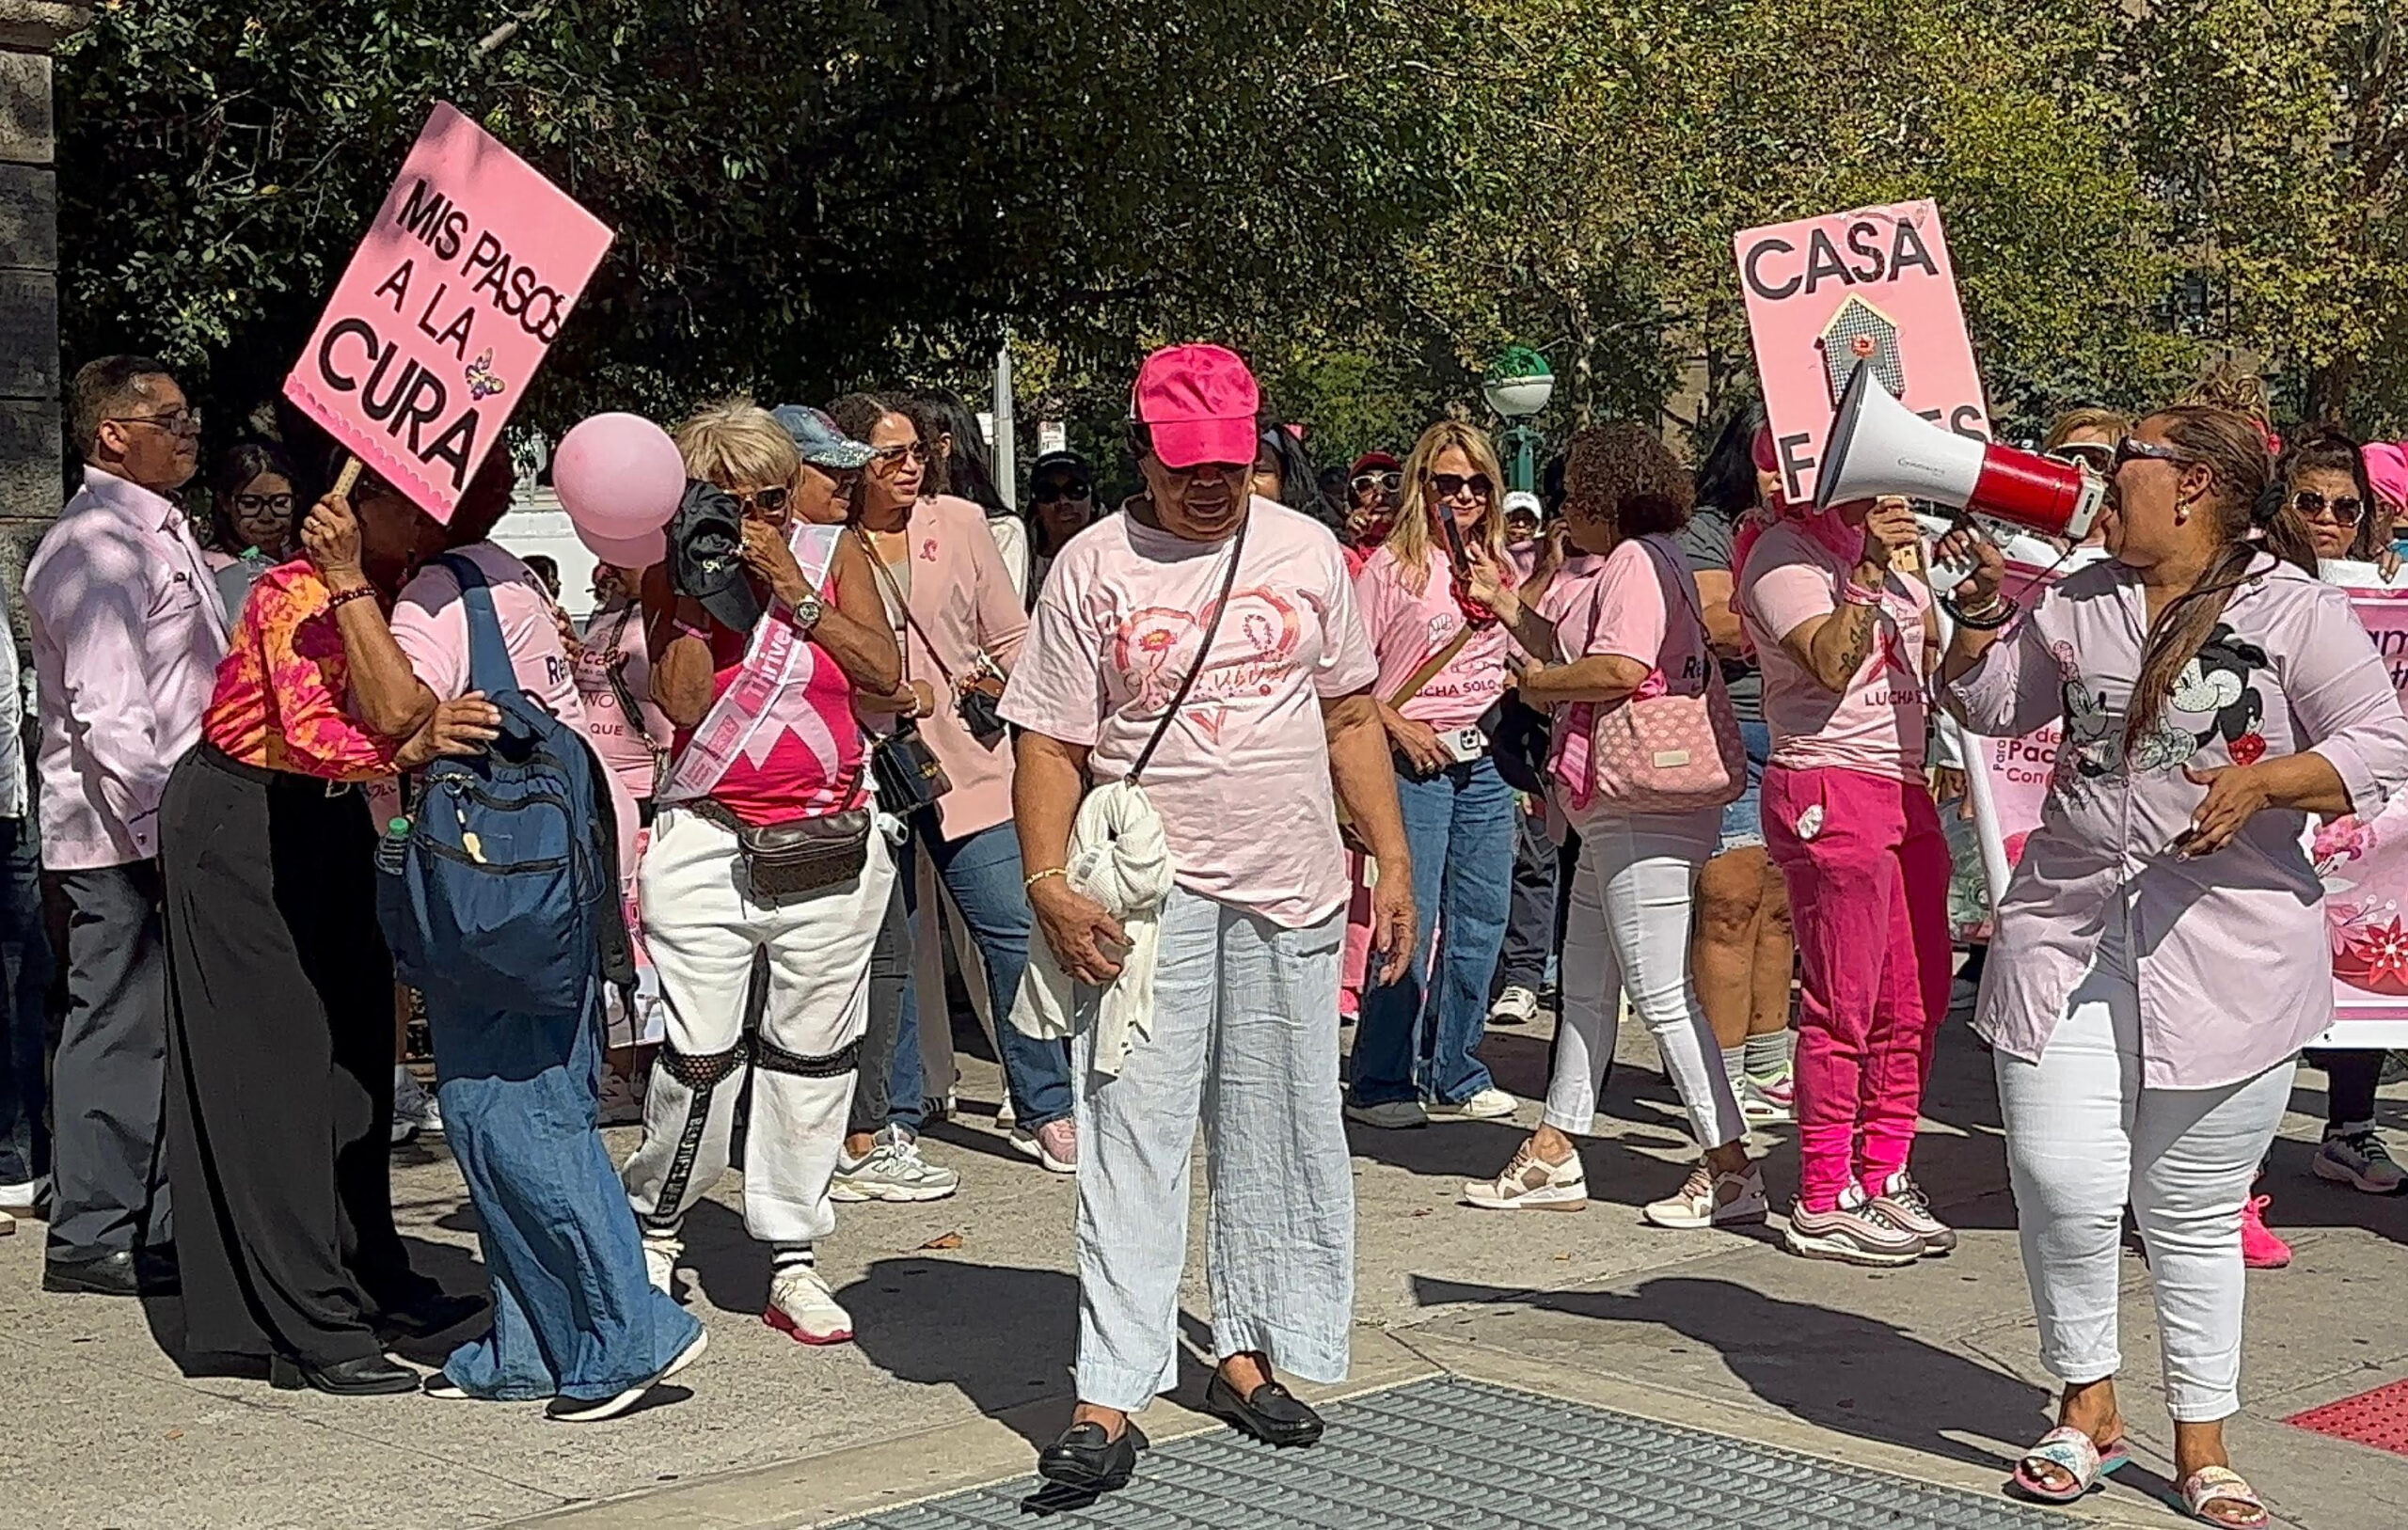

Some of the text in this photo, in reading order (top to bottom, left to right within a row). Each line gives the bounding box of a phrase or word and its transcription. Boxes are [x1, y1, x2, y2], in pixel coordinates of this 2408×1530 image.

[396, 179, 564, 344] MIS PASOS
[1745, 217, 1939, 300] CASA
[375, 260, 475, 361] A LA
[319, 319, 479, 492] CURA
[590, 723, 624, 736] QUE
[1463, 679, 1497, 693] SOLO
